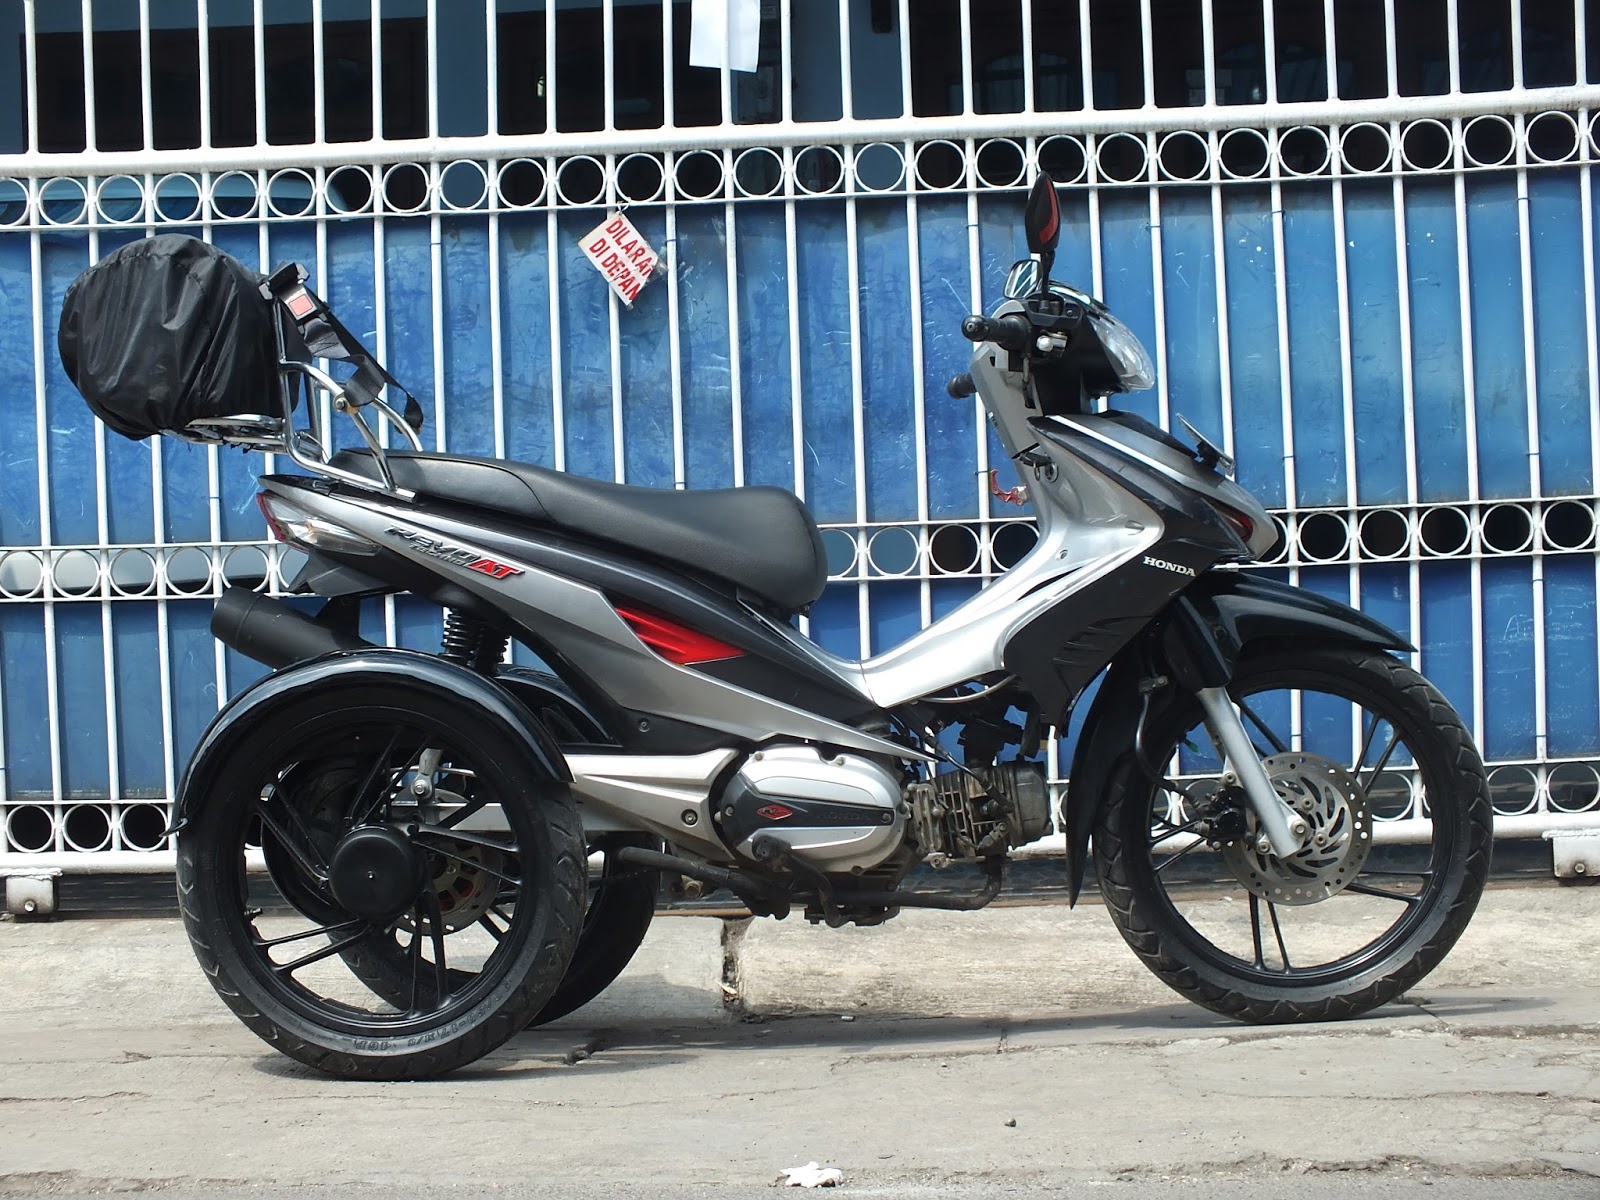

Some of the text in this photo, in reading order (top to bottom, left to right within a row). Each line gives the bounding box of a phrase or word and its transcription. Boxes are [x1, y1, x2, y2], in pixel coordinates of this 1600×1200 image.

[589, 237, 641, 300] DI DEPAN
[466, 558, 525, 580] AT
[1143, 556, 1196, 577] HONDA
